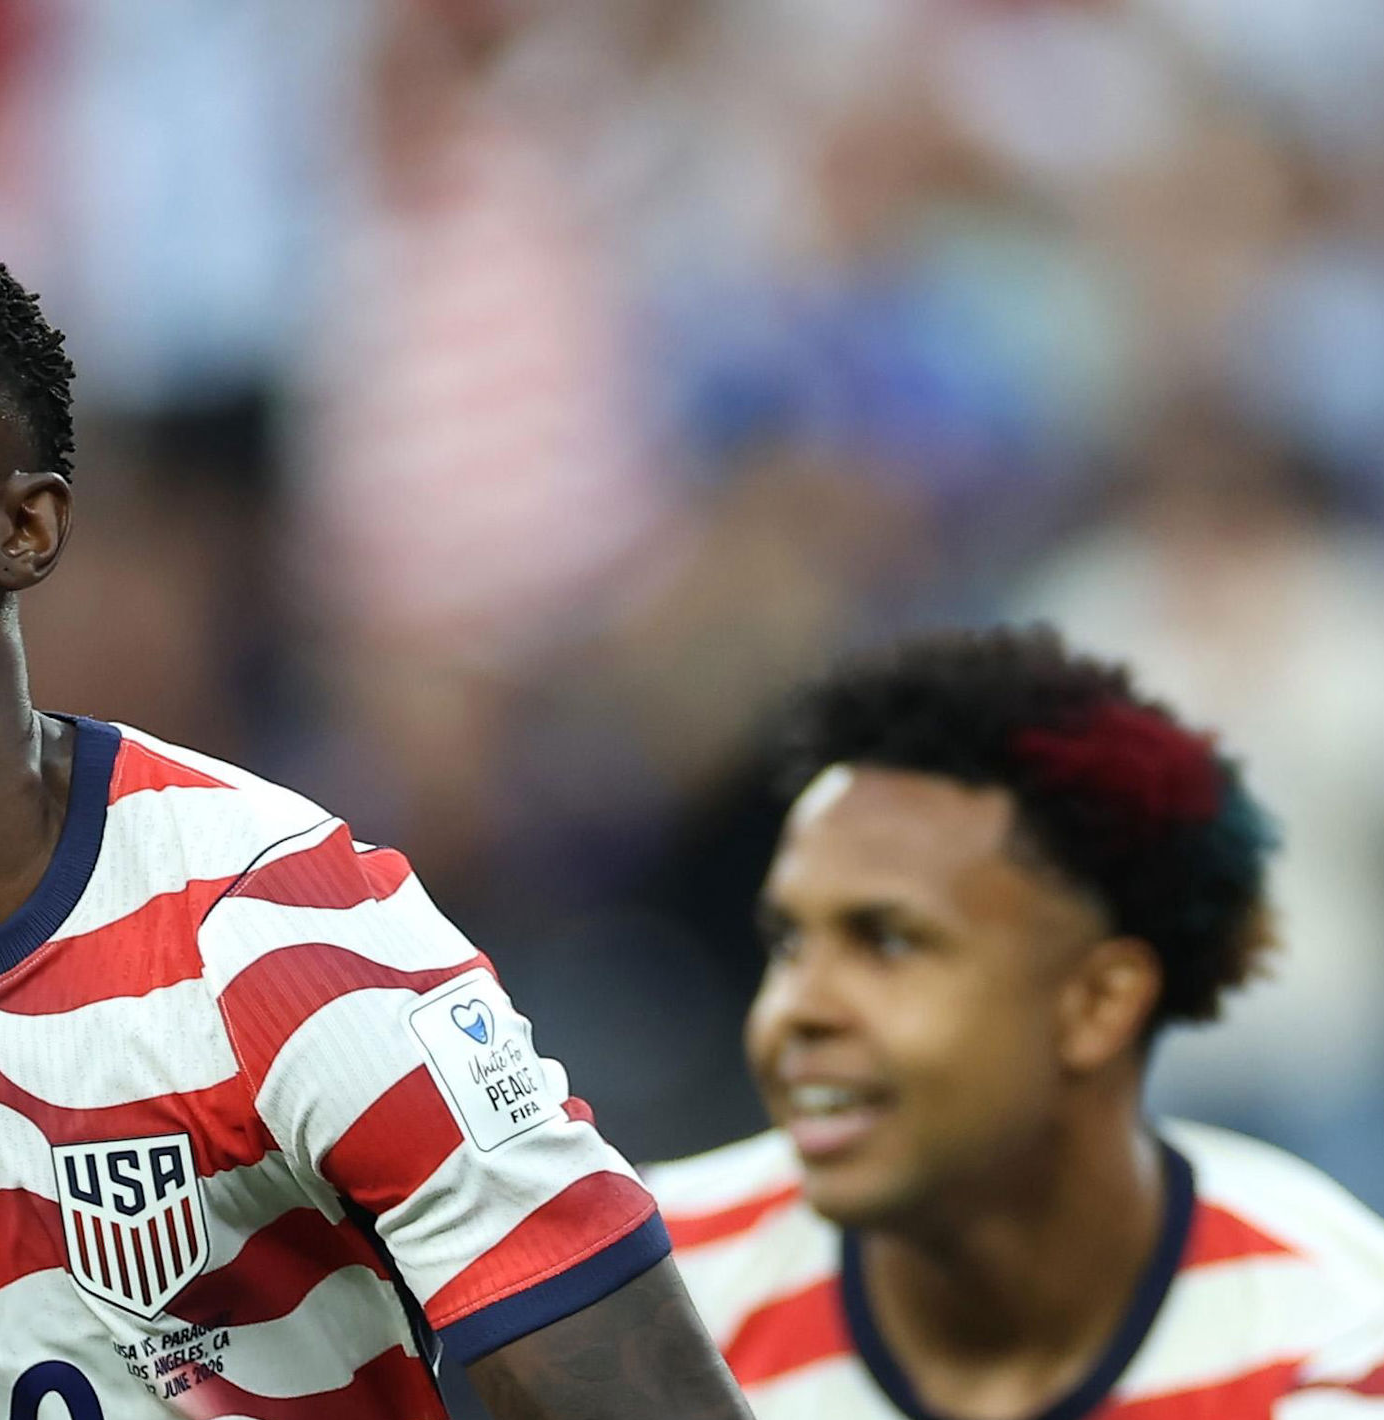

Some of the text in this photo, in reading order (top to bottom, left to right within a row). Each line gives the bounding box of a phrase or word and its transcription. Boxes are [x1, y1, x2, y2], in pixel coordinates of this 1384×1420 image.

[468, 1051, 507, 1085] Unite
[486, 1067, 538, 1112] PEACE
[511, 1101, 540, 1124] FIFA
[63, 1145, 186, 1216] USA
[127, 1362, 149, 1380] LOS
[213, 1331, 230, 1350] CA
[163, 1372, 191, 1399] JUNE
[193, 1355, 224, 1385] 2026
